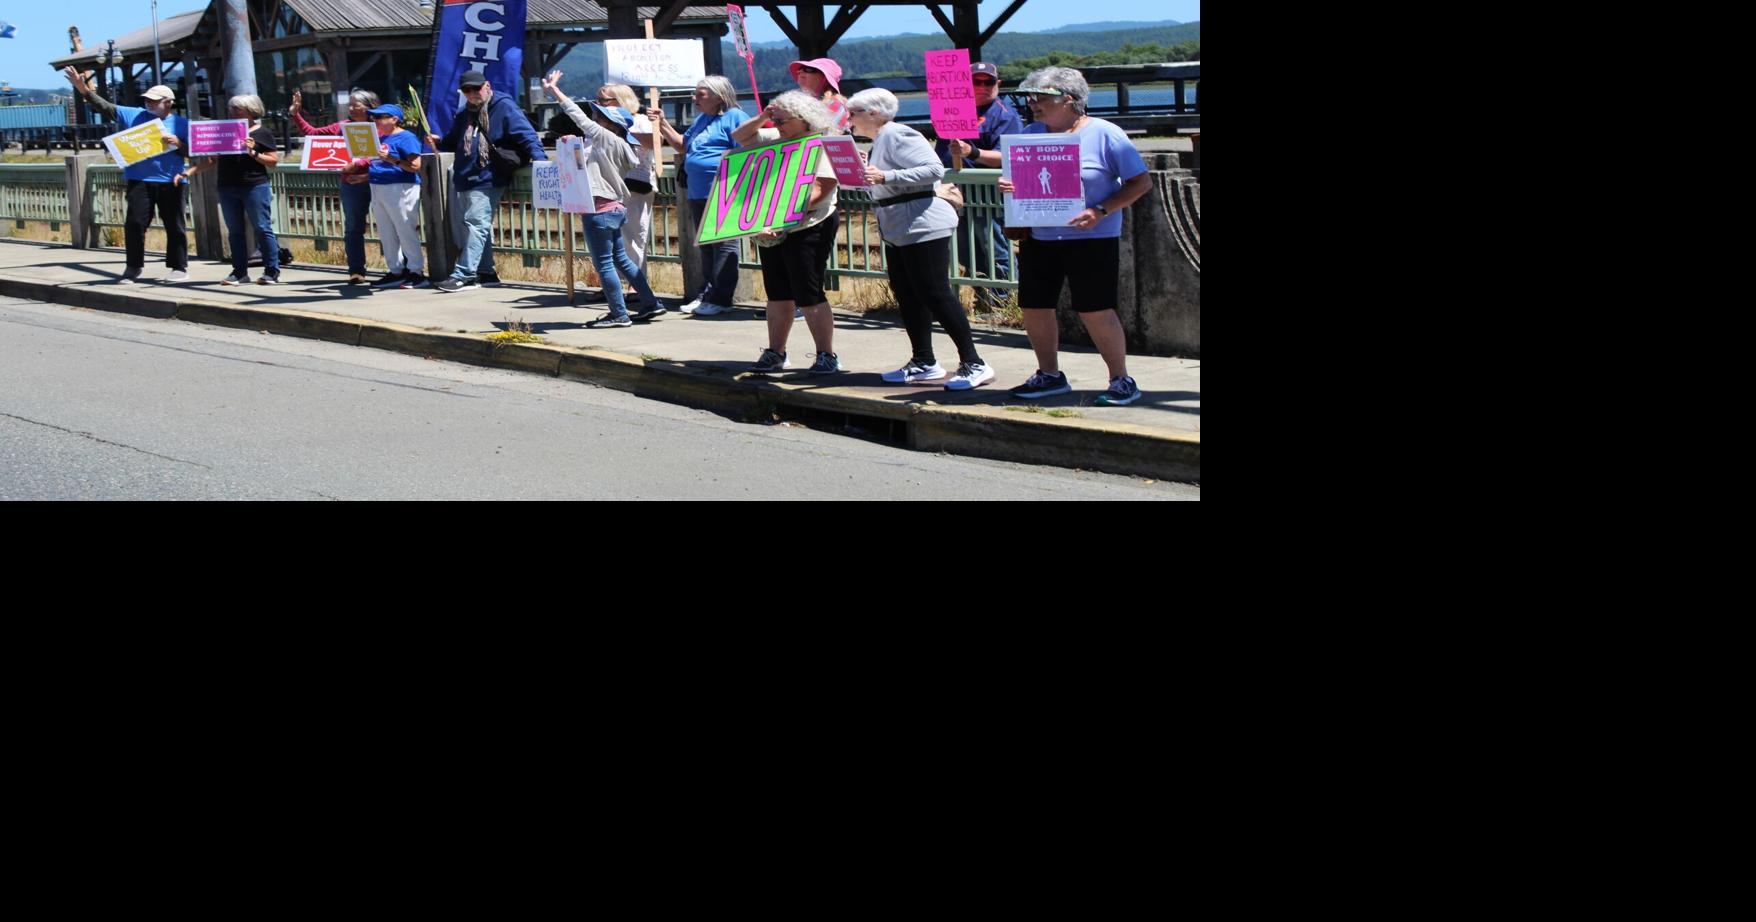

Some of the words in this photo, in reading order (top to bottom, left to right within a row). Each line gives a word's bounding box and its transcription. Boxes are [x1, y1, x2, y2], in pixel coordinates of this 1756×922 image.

[930, 54, 958, 67] KEEP
[635, 64, 679, 73] ACCESS
[928, 71, 970, 84] ABORTION
[943, 107, 960, 115] AND
[1036, 154, 1074, 162] CHOICE
[536, 166, 559, 178] REPR
[539, 179, 560, 189] RIGHT
[715, 138, 822, 236] VOTE
